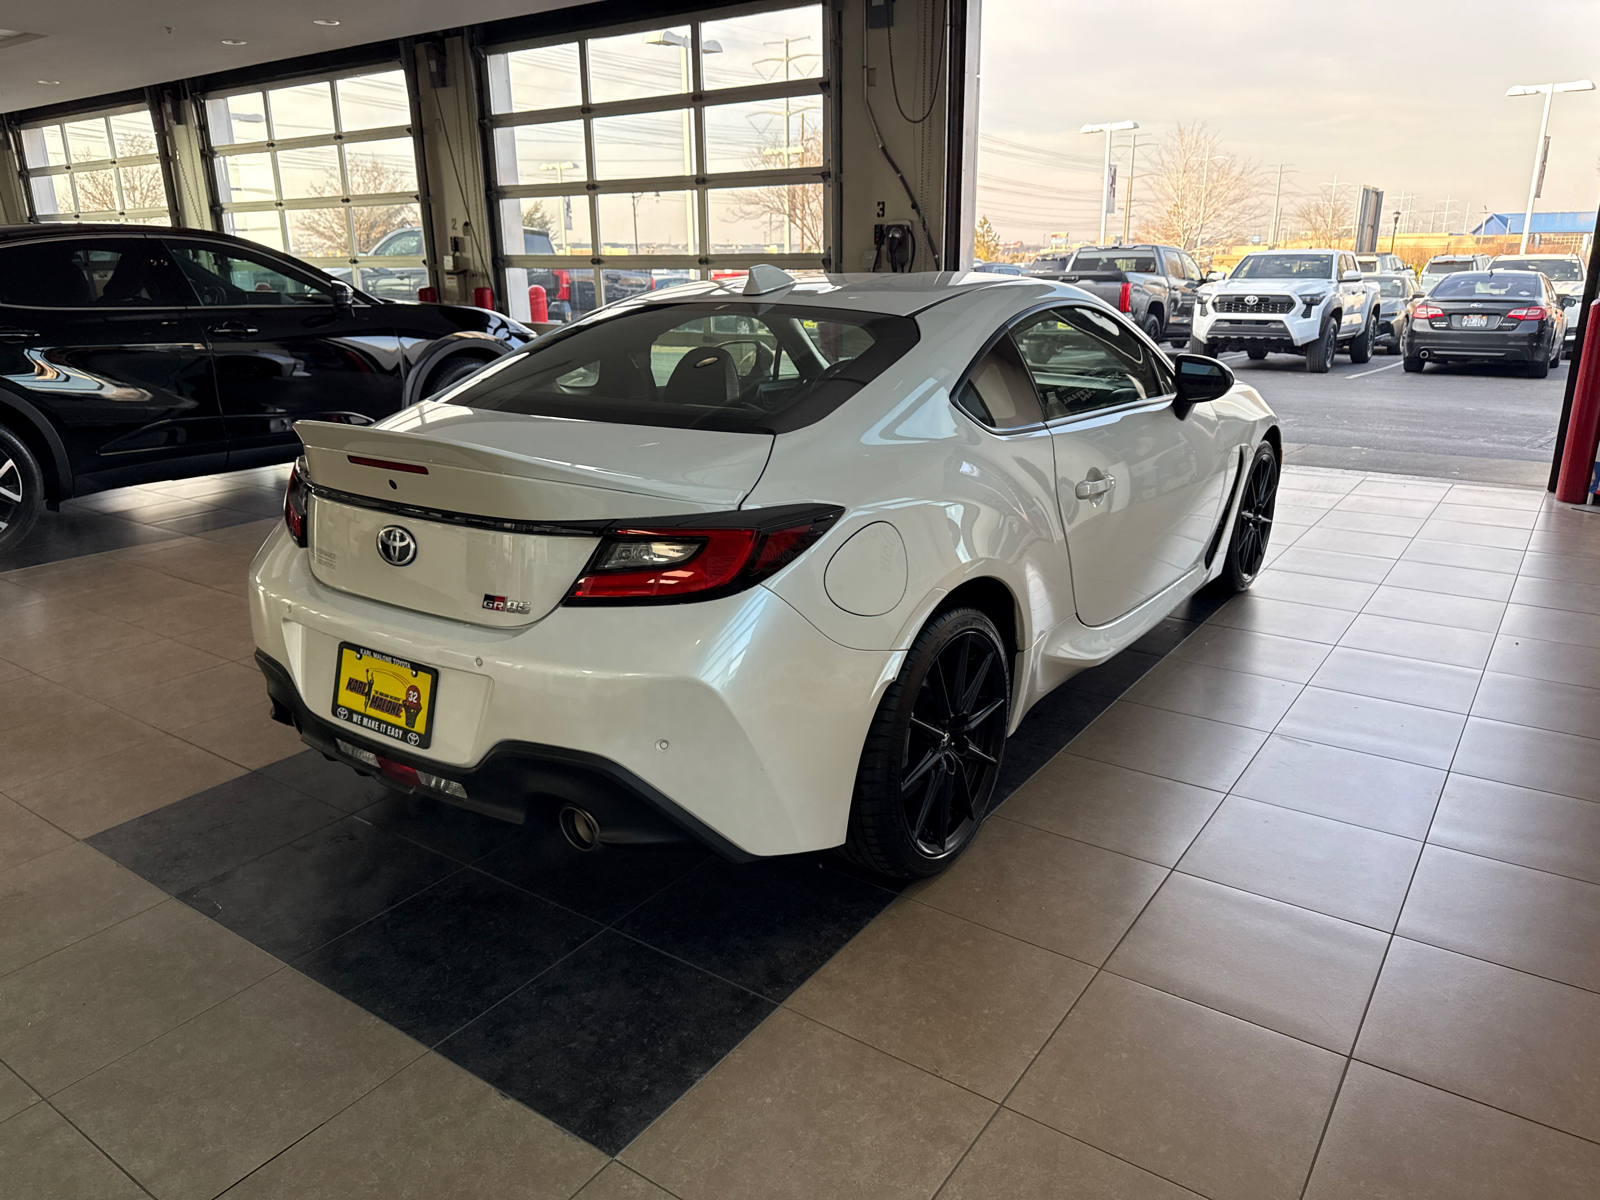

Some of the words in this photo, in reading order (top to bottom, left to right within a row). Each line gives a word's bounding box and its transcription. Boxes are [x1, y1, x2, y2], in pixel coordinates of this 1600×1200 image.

[877, 201, 885, 217] 3
[451, 217, 458, 230] 2
[393, 658, 411, 669] TOYOTA
[346, 677, 367, 697] KARL
[408, 690, 418, 703] 32
[369, 694, 404, 718] MALONE
[352, 713, 362, 724] WE
[362, 717, 379, 731] MAKE
[380, 723, 387, 733] IT
[387, 725, 403, 739] EASY
